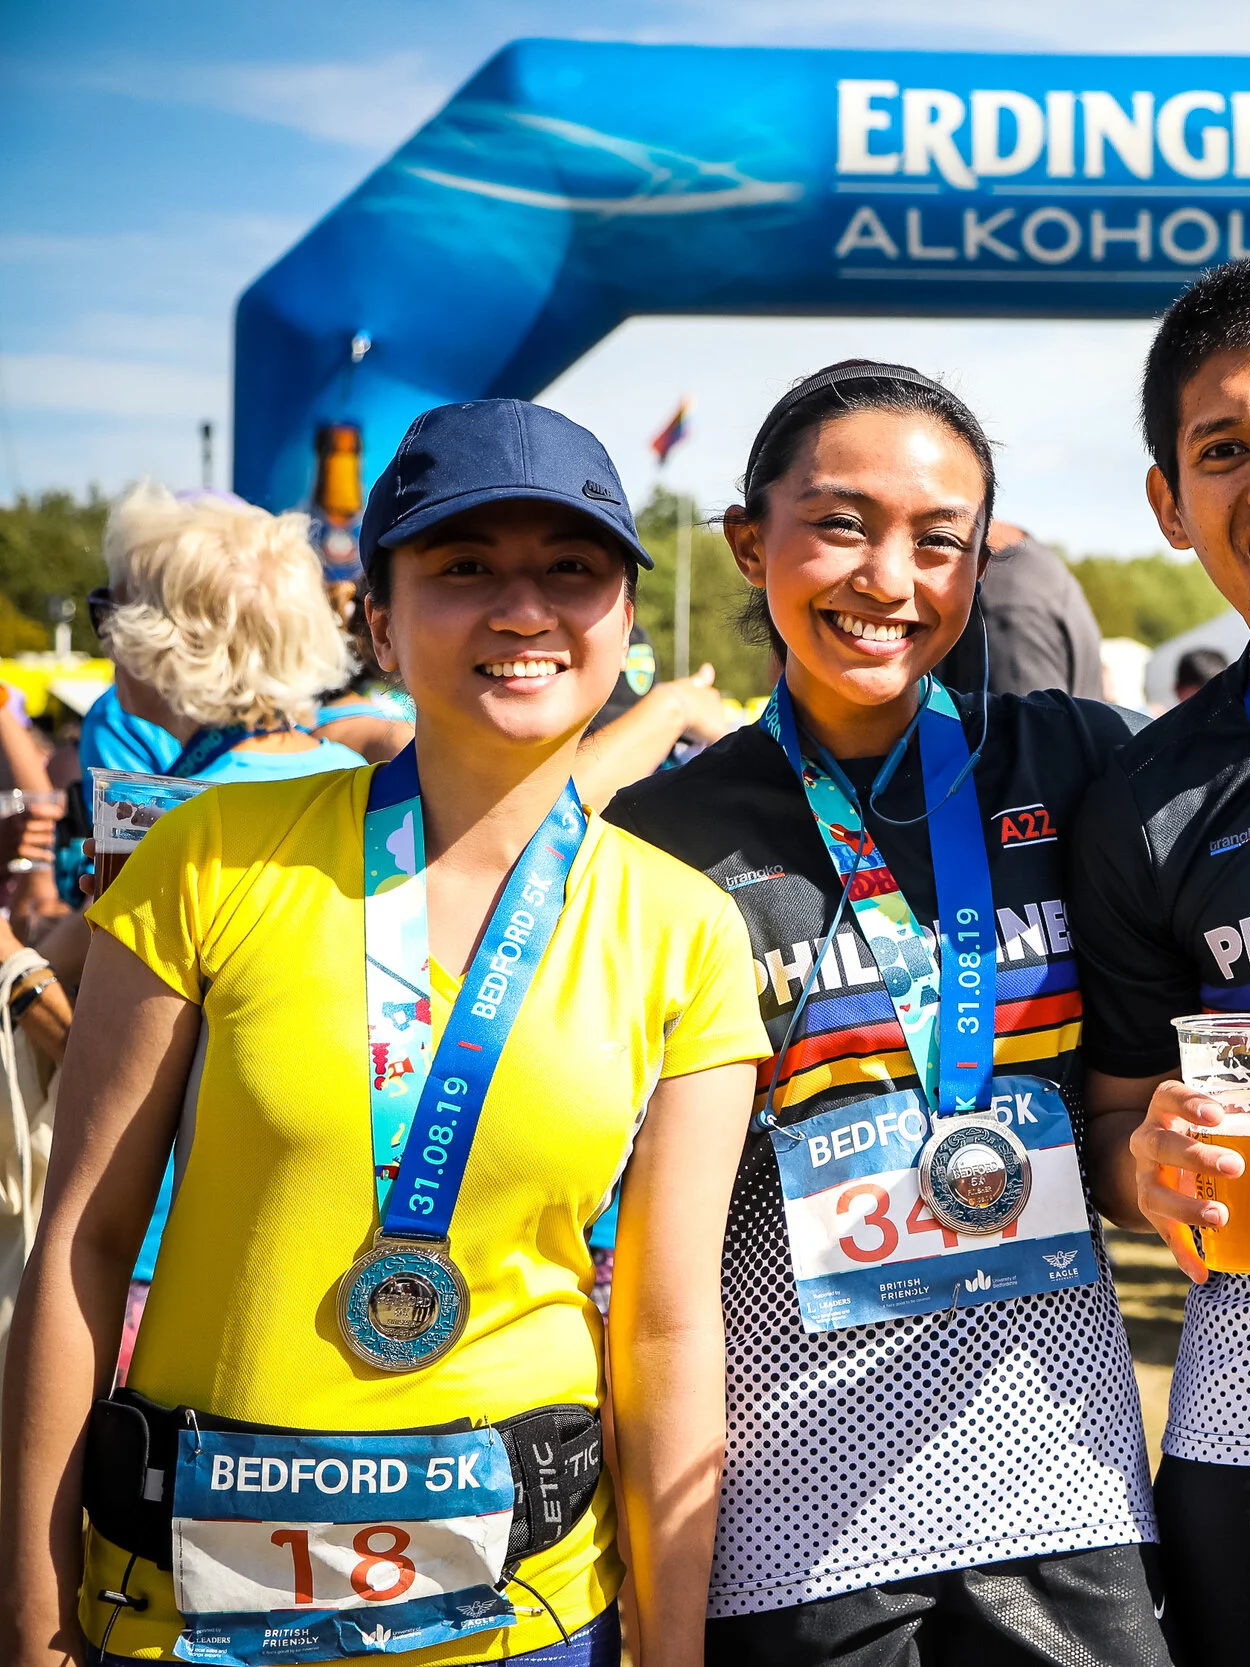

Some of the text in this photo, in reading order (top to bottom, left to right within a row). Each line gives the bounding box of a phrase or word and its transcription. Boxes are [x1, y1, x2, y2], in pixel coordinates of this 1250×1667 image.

[1000, 810, 1057, 844] A2Z
[955, 907, 981, 1034] 31.08.19
[408, 1075, 469, 1217] 31.08.19
[472, 908, 536, 1022] BEDFORD
[521, 873, 553, 908] 5K
[998, 1092, 1039, 1127] 5K
[836, 1183, 1020, 1263] 34
[879, 1278, 921, 1292] BRITISH
[1048, 1267, 1079, 1280] EAGLE
[818, 1297, 852, 1309] LEADERS
[210, 1453, 481, 1495] BEDFORD 5K
[270, 1525, 417, 1605] 18
[264, 1628, 310, 1638] BRITISH
[460, 1616, 496, 1629] EAGLE
[196, 1636, 231, 1644] LEADERS
